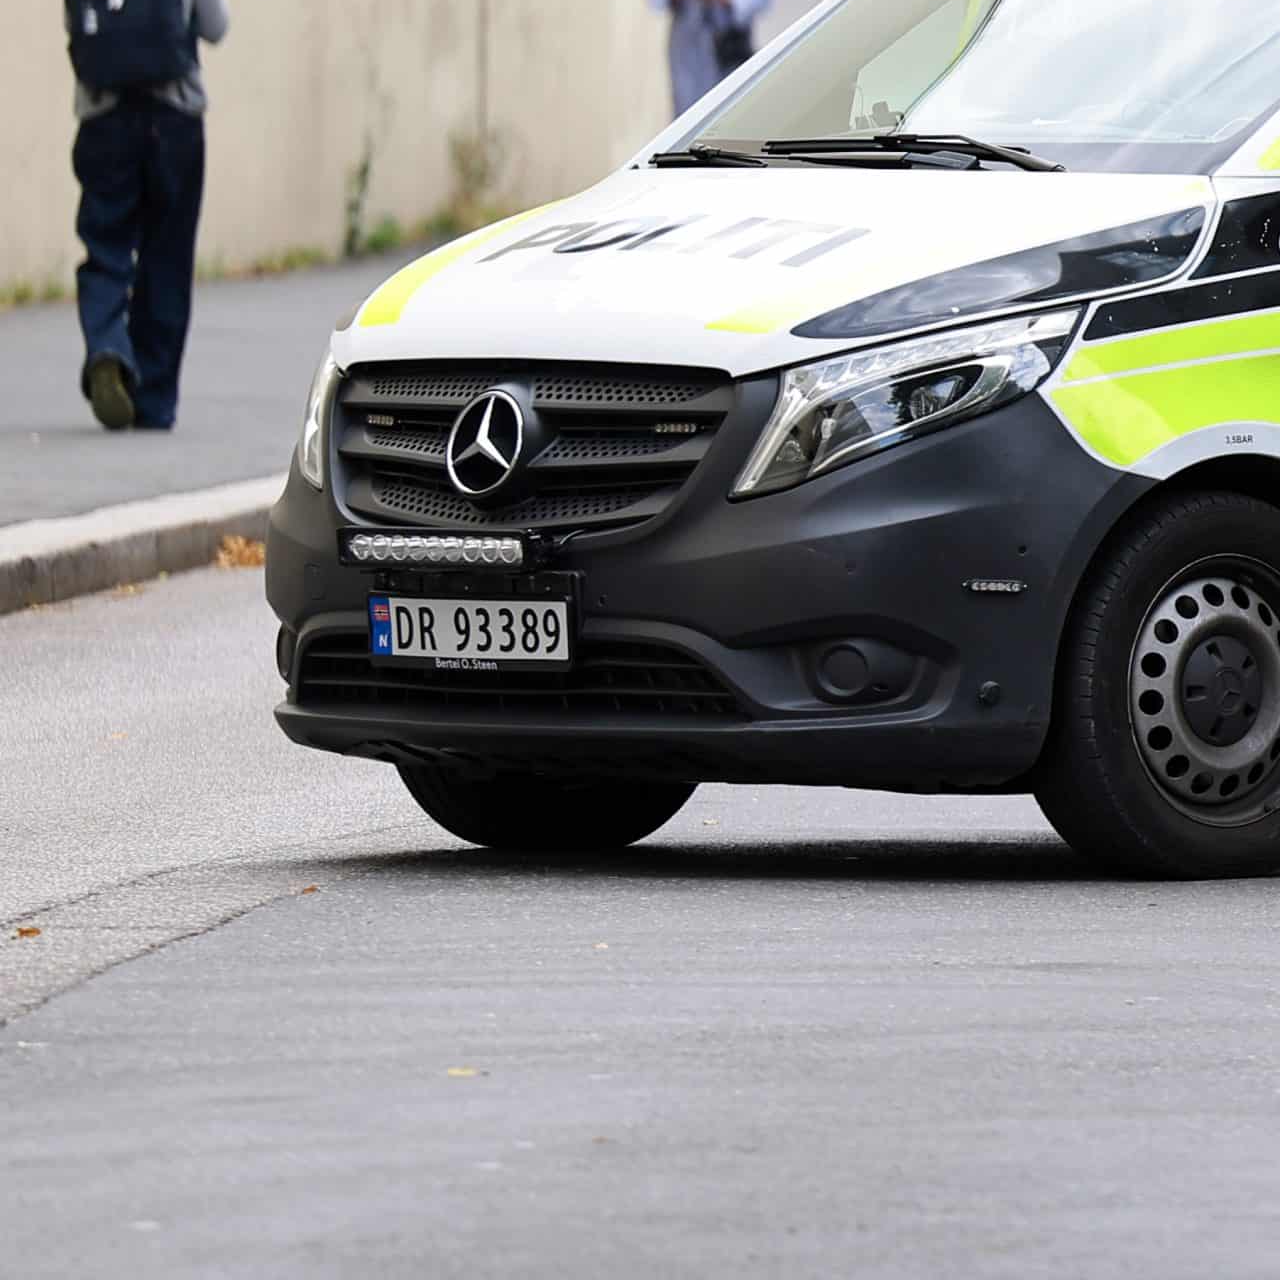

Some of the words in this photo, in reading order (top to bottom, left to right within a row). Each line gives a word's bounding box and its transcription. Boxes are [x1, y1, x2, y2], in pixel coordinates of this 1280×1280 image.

[475, 214, 872, 267] POLITI
[379, 634, 389, 648] N
[395, 606, 437, 650] DR
[454, 607, 560, 654] 93389
